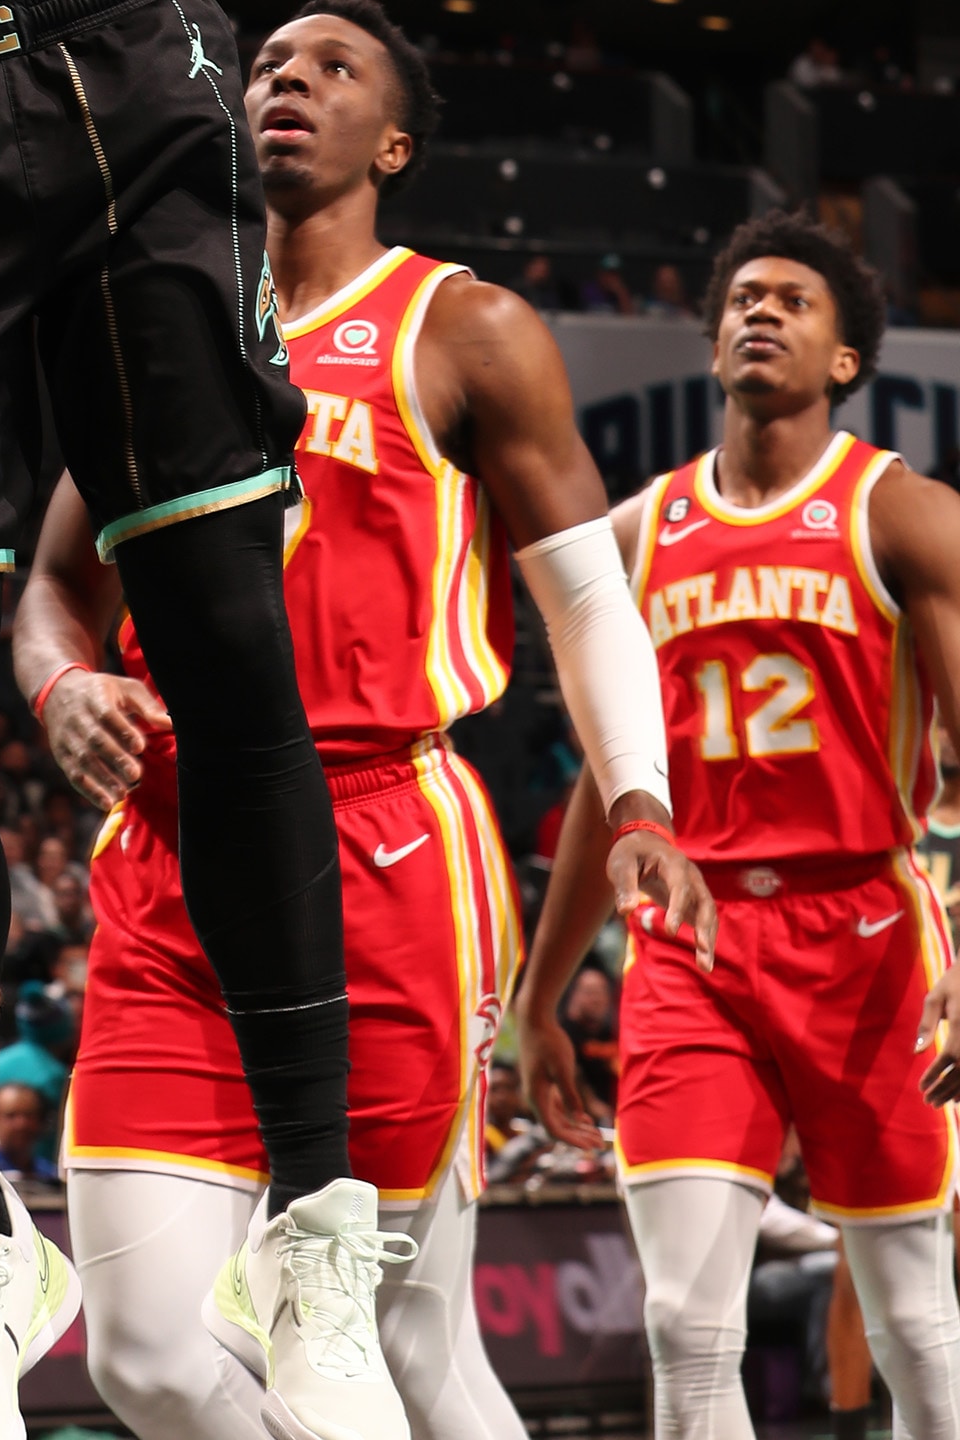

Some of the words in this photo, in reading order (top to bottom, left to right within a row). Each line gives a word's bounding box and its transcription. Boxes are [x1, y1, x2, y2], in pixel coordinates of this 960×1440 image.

[316, 355, 380, 366] sharecare
[295, 389, 380, 475] TA
[670, 497, 690, 521] 6
[649, 564, 859, 651] ATLANTA
[695, 653, 820, 762] 12
